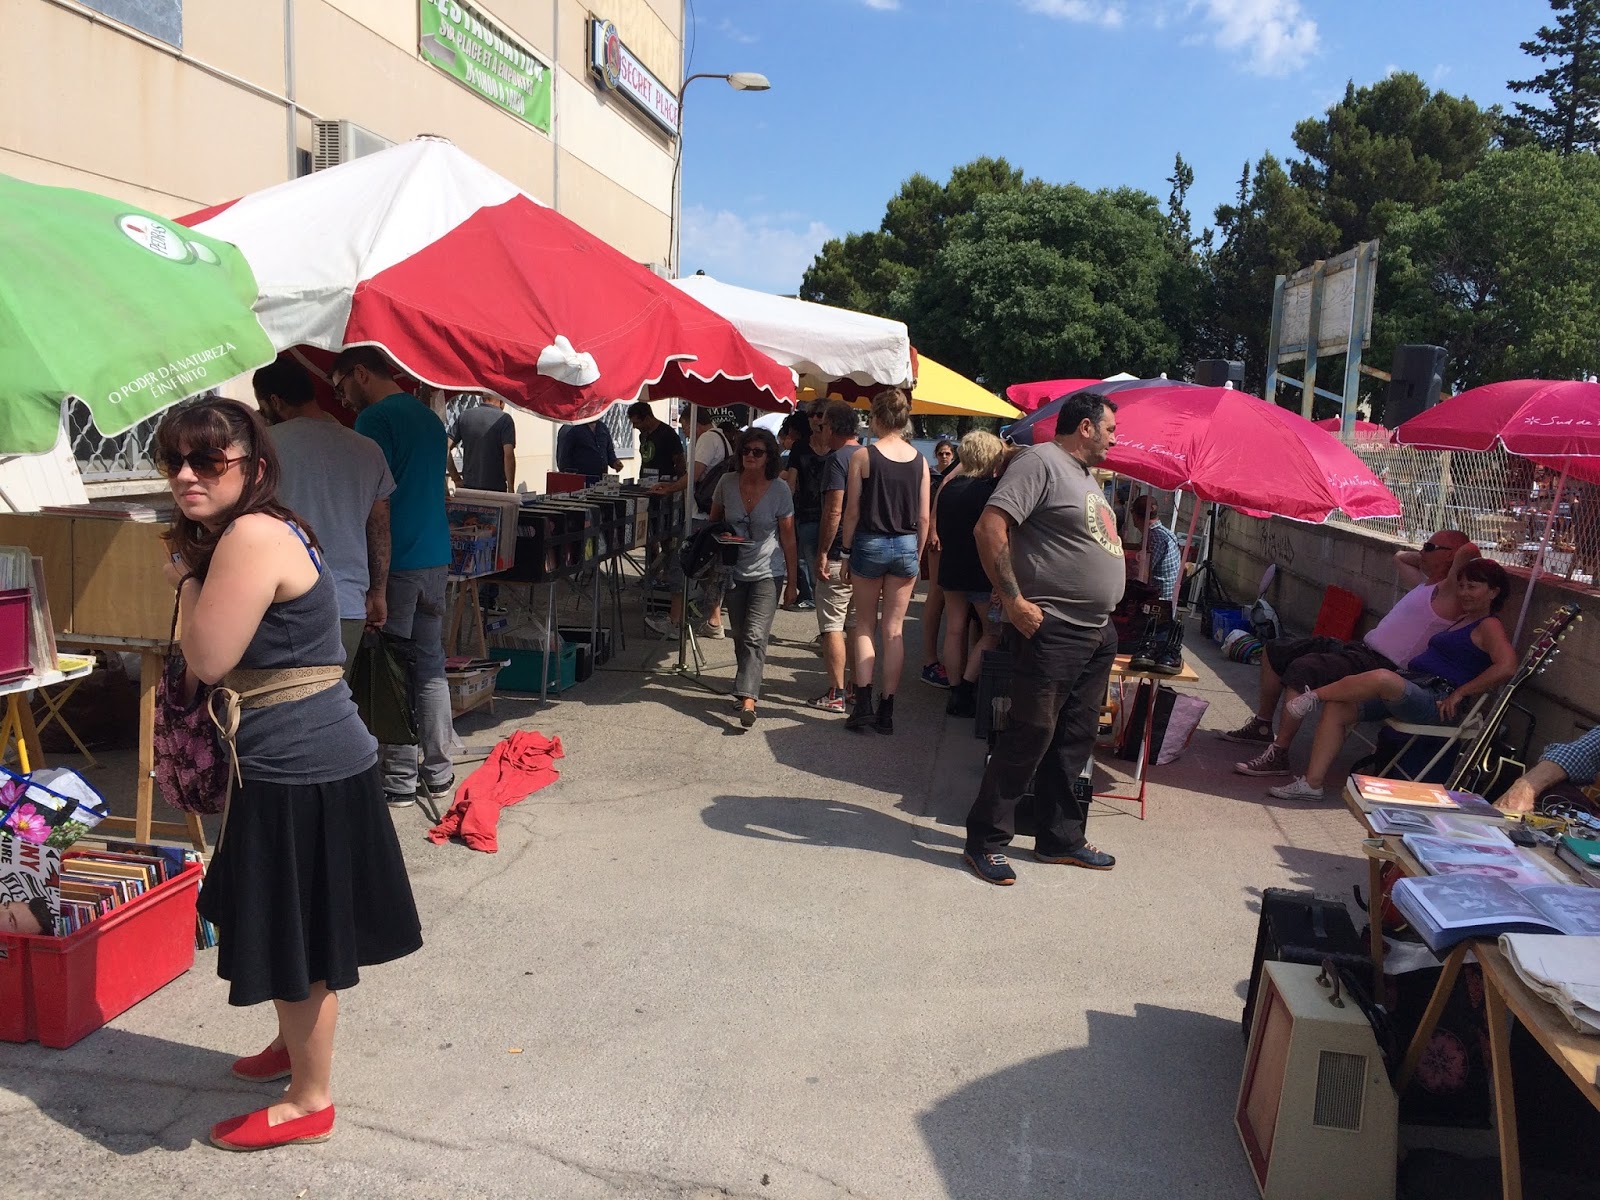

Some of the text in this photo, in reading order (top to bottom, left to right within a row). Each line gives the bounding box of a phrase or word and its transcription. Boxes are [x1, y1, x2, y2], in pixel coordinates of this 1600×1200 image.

[457, 31, 482, 62] PLACE
[482, 49, 492, 68] ET
[622, 55, 678, 126] SECRET PLACE
[149, 223, 168, 255] PEDRAS
[108, 341, 236, 404] O PODER DA NATUREZA
[157, 366, 207, 394] INFINITO
[1540, 415, 1573, 425] Sud
[20, 841, 40, 872] NY
